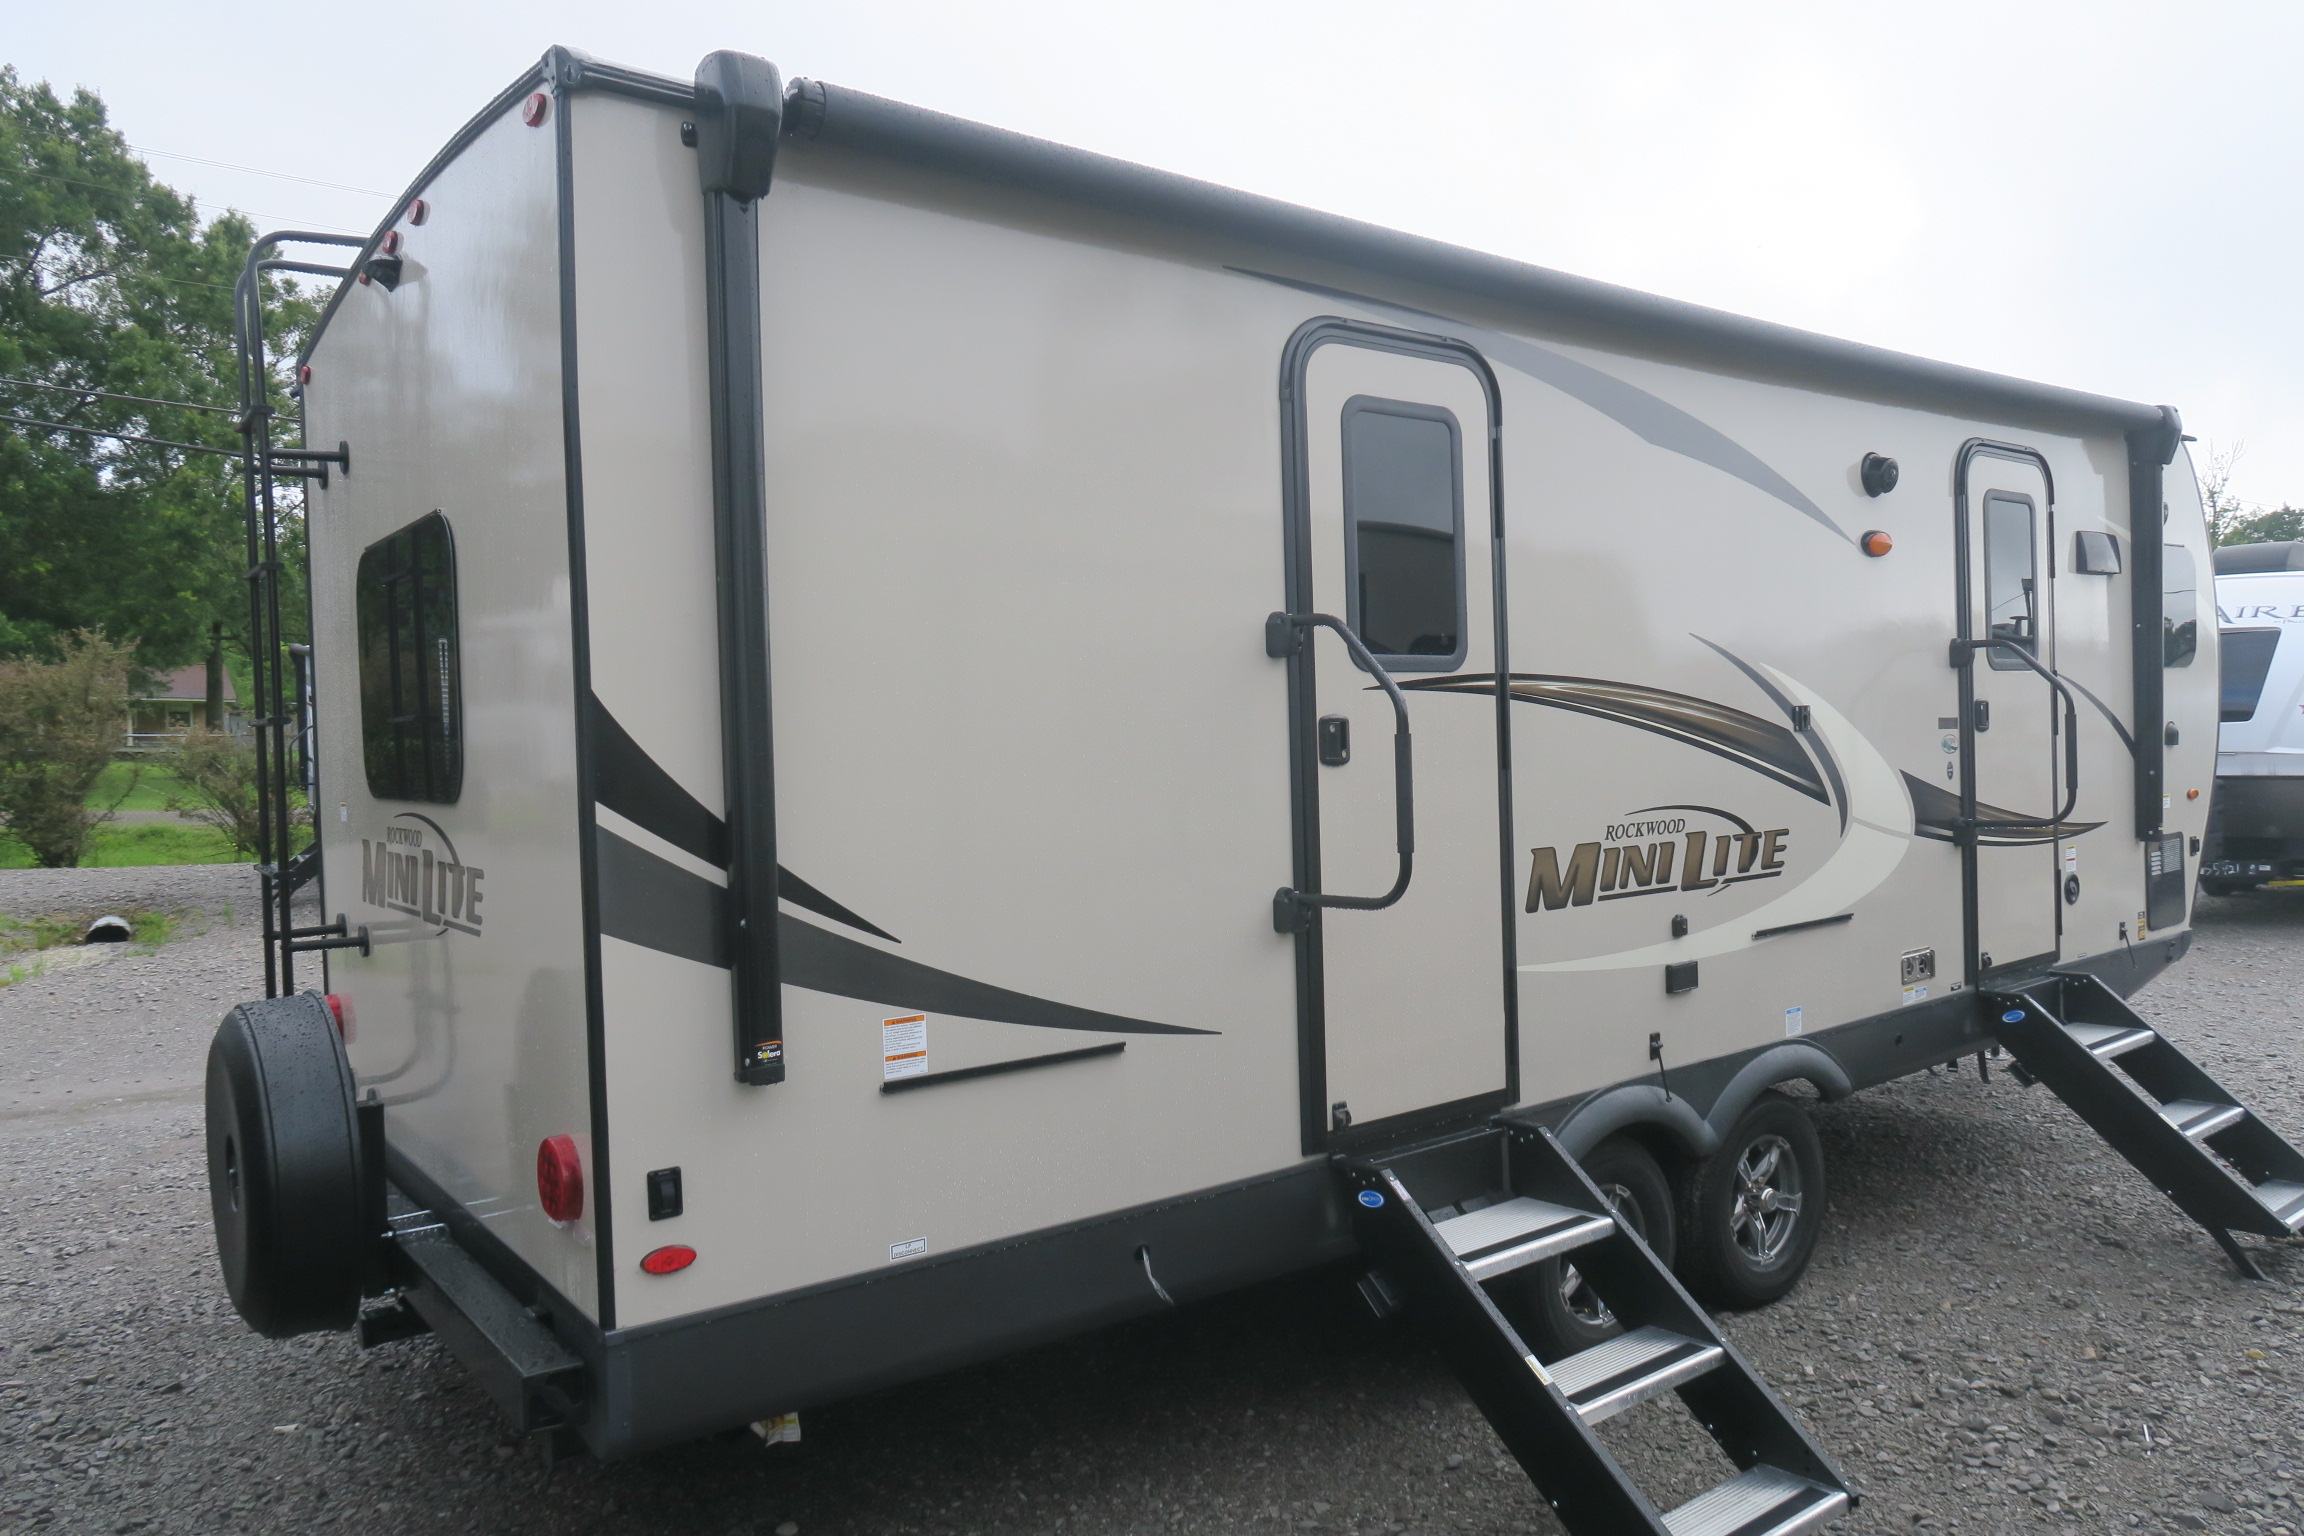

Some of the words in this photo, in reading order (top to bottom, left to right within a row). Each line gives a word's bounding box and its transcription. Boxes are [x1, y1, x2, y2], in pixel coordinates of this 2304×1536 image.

[386, 826, 423, 848] ROCKWOOD
[1604, 818, 1686, 842] ROCKWOOD
[757, 1050, 781, 1060] Solera
